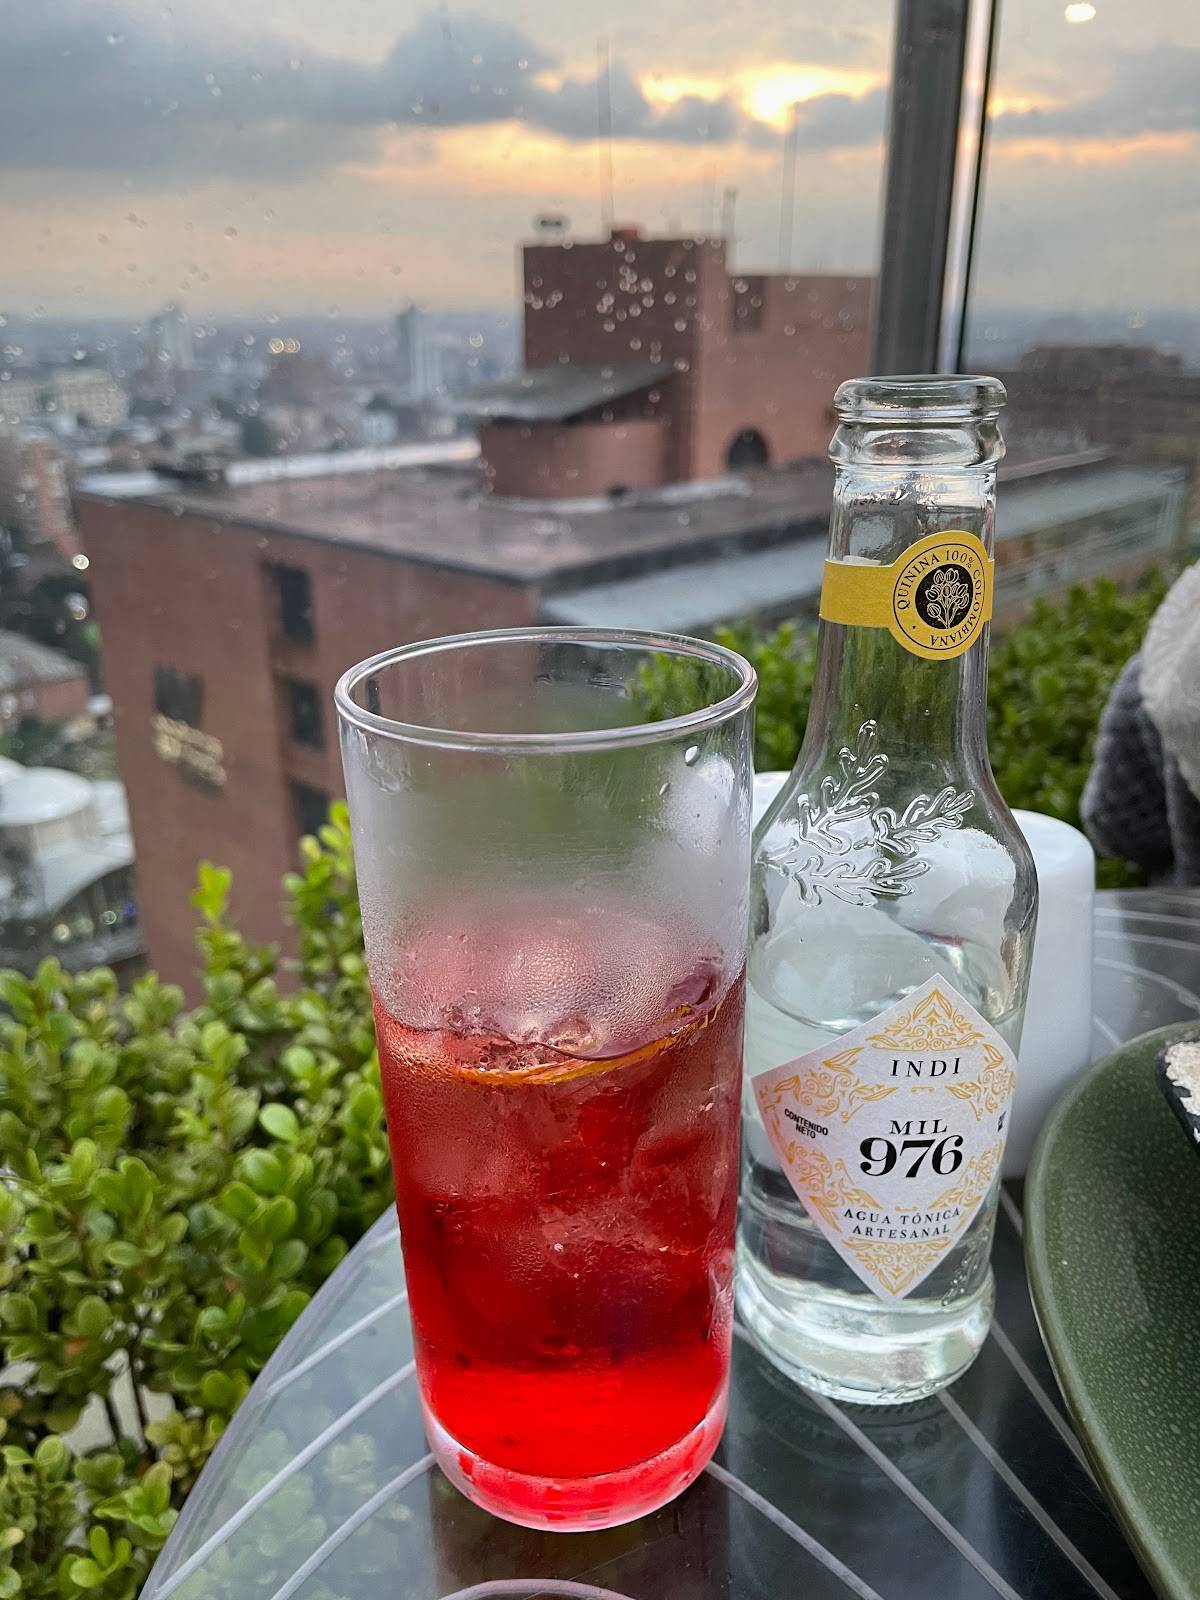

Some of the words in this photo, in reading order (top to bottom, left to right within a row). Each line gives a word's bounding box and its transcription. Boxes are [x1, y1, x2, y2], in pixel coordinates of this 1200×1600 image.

[945, 549, 975, 569] 100%
[898, 553, 940, 610] QUININA
[930, 569, 982, 647] COLOMBIANA
[891, 1057, 960, 1077] INDI
[784, 1108, 829, 1136] CONTENIDO
[795, 1123, 816, 1139] NETO
[889, 1119, 949, 1135] MIL
[859, 1134, 964, 1178] 976
[843, 1208, 891, 1225] AGUA
[900, 1207, 960, 1225] TÓNICA
[852, 1225, 950, 1239] ARTESANAL
